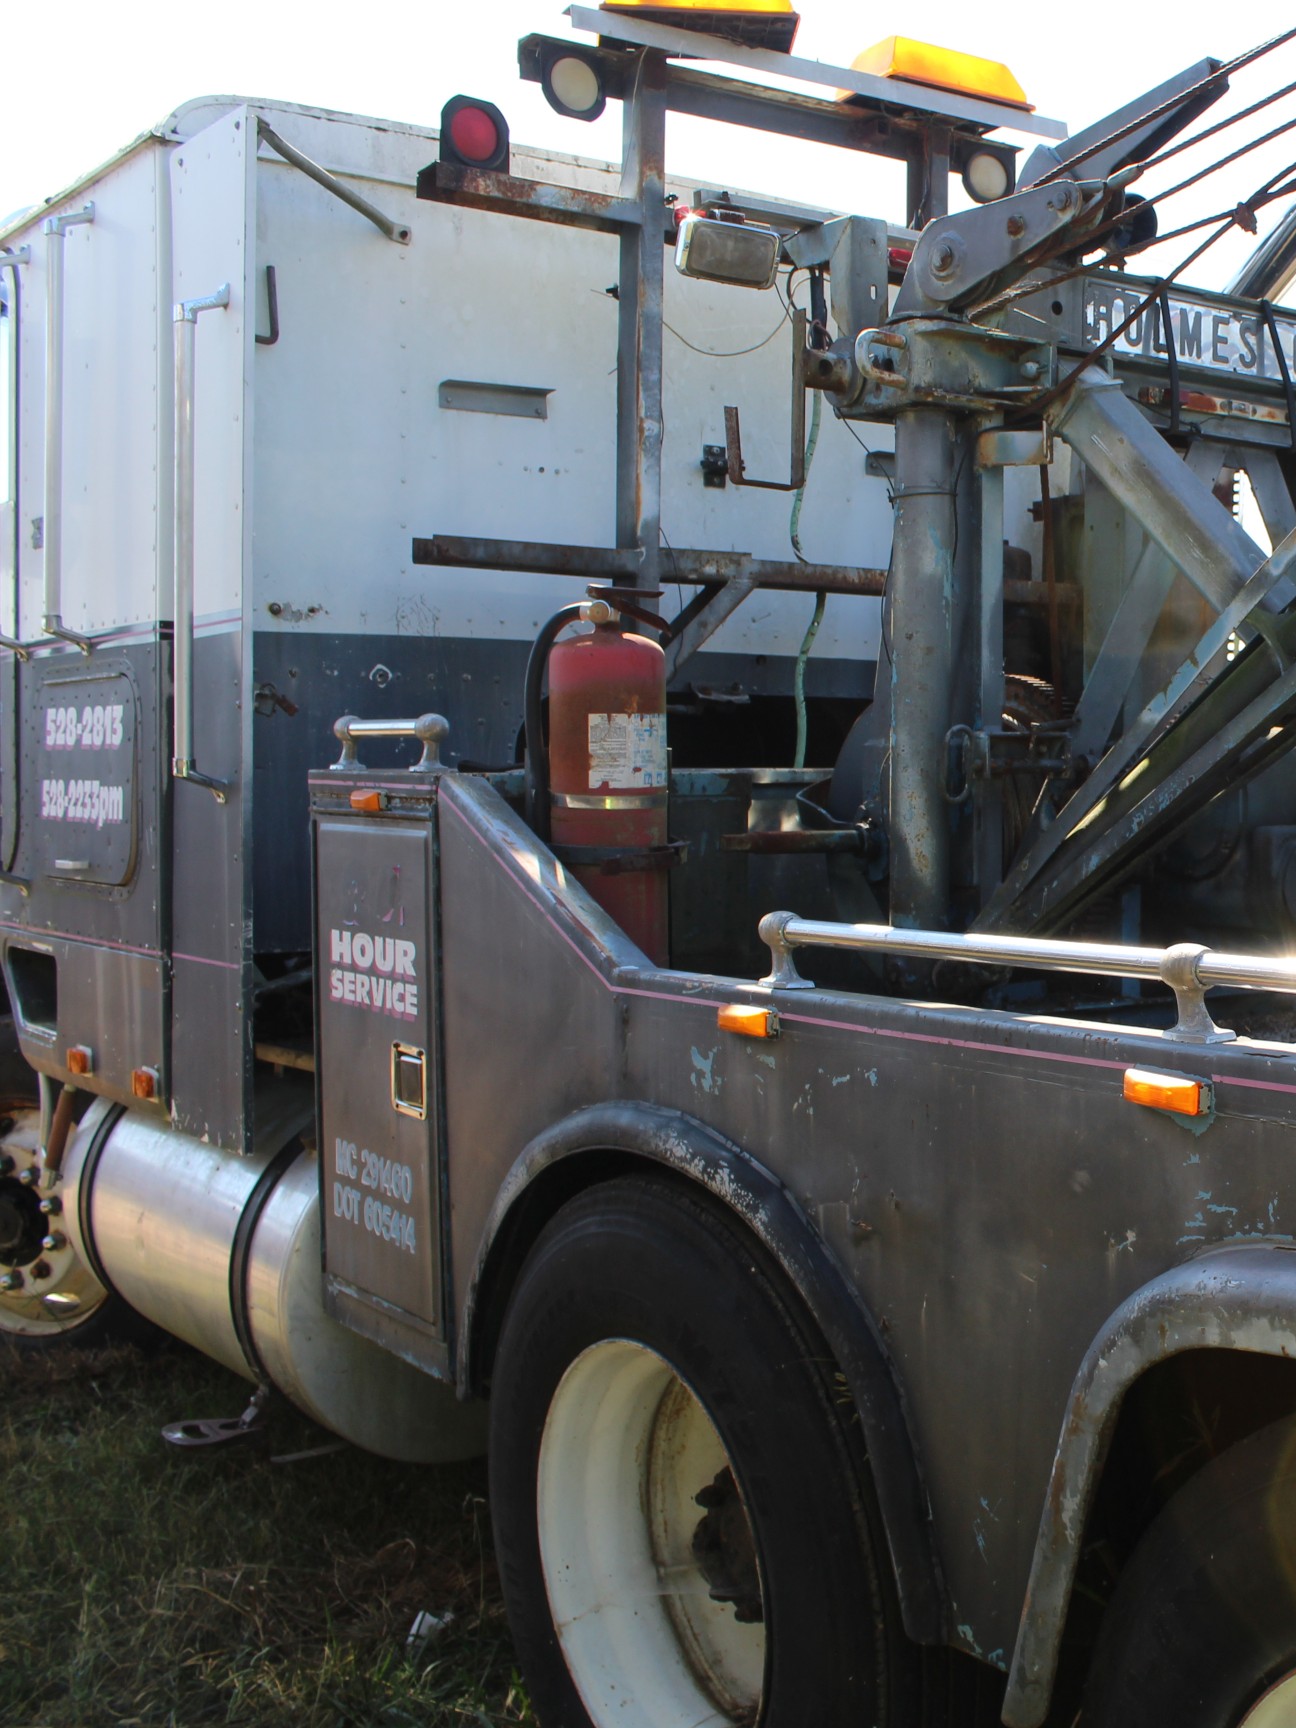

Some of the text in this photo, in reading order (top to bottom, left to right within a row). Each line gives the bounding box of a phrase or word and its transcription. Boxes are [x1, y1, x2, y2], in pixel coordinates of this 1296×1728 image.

[45, 705, 124, 748] 528-2813
[42, 779, 124, 827] 528-2233pm
[330, 929, 416, 979] HOUR
[330, 968, 418, 1018] SERVICE
[335, 1138, 413, 1204] MC 291460
[333, 1182, 416, 1254] DOT 605414
